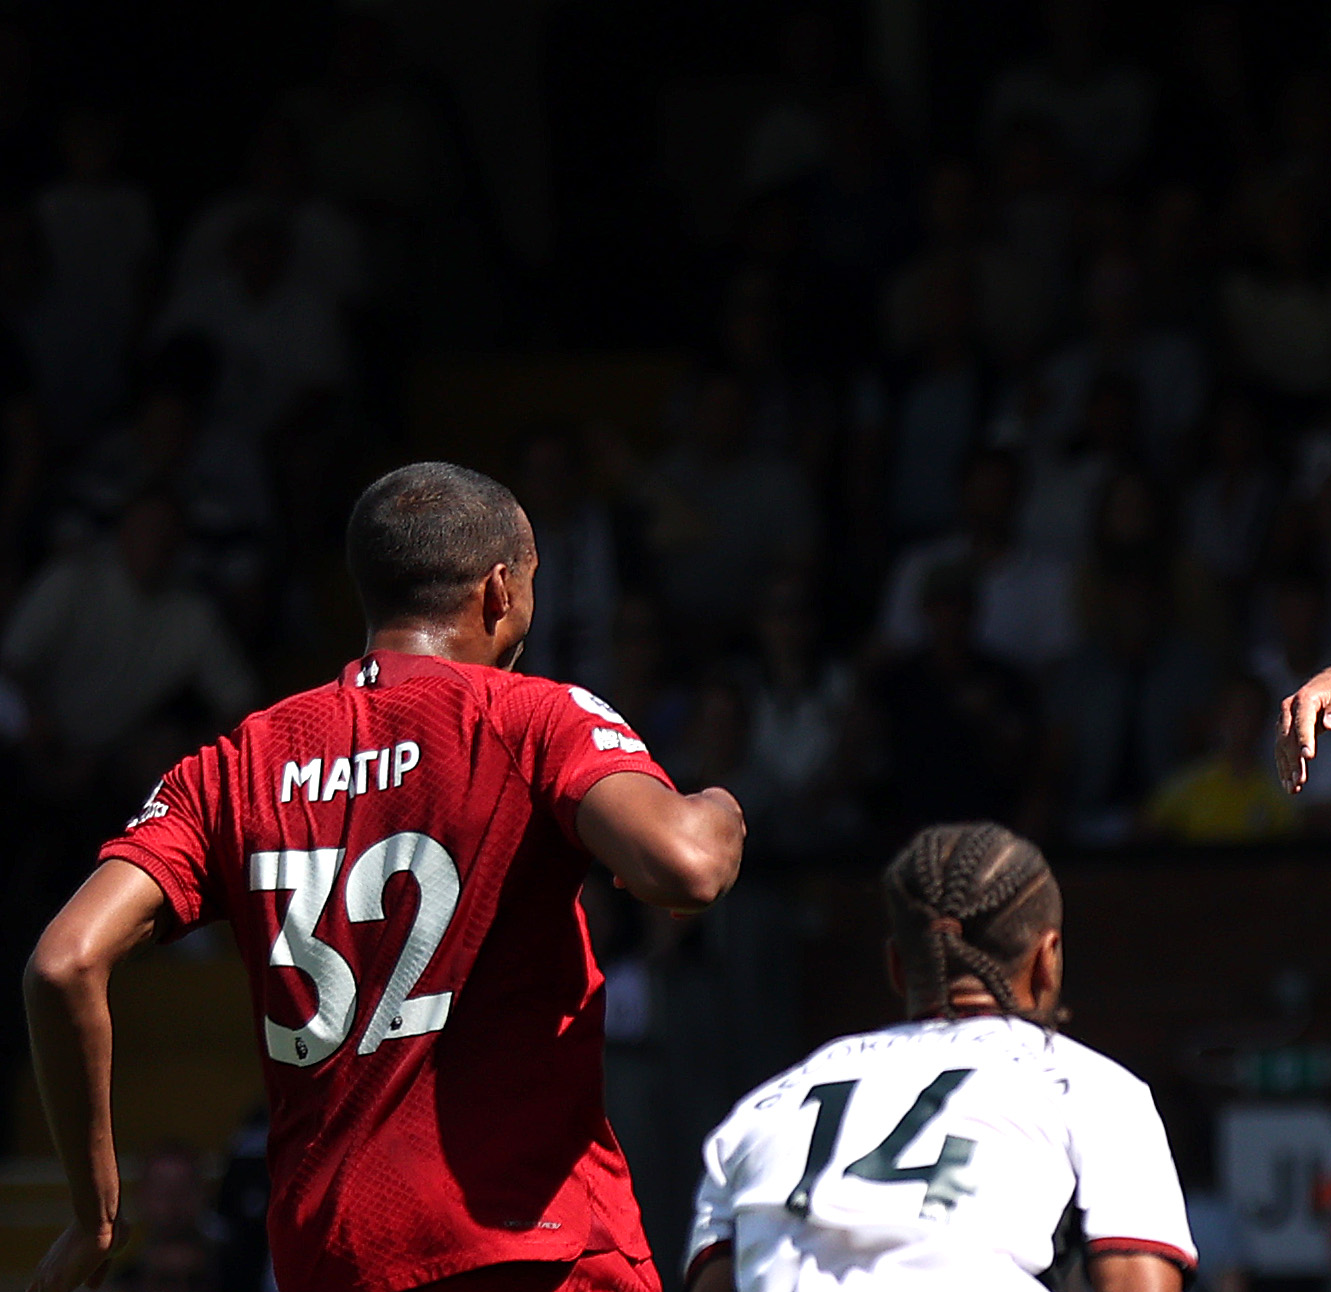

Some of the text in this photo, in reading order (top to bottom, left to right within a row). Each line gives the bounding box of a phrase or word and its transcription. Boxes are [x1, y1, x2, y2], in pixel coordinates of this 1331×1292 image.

[281, 741, 420, 803] MATIP
[250, 832, 460, 1067] 32
[786, 1068, 978, 1222] 14
